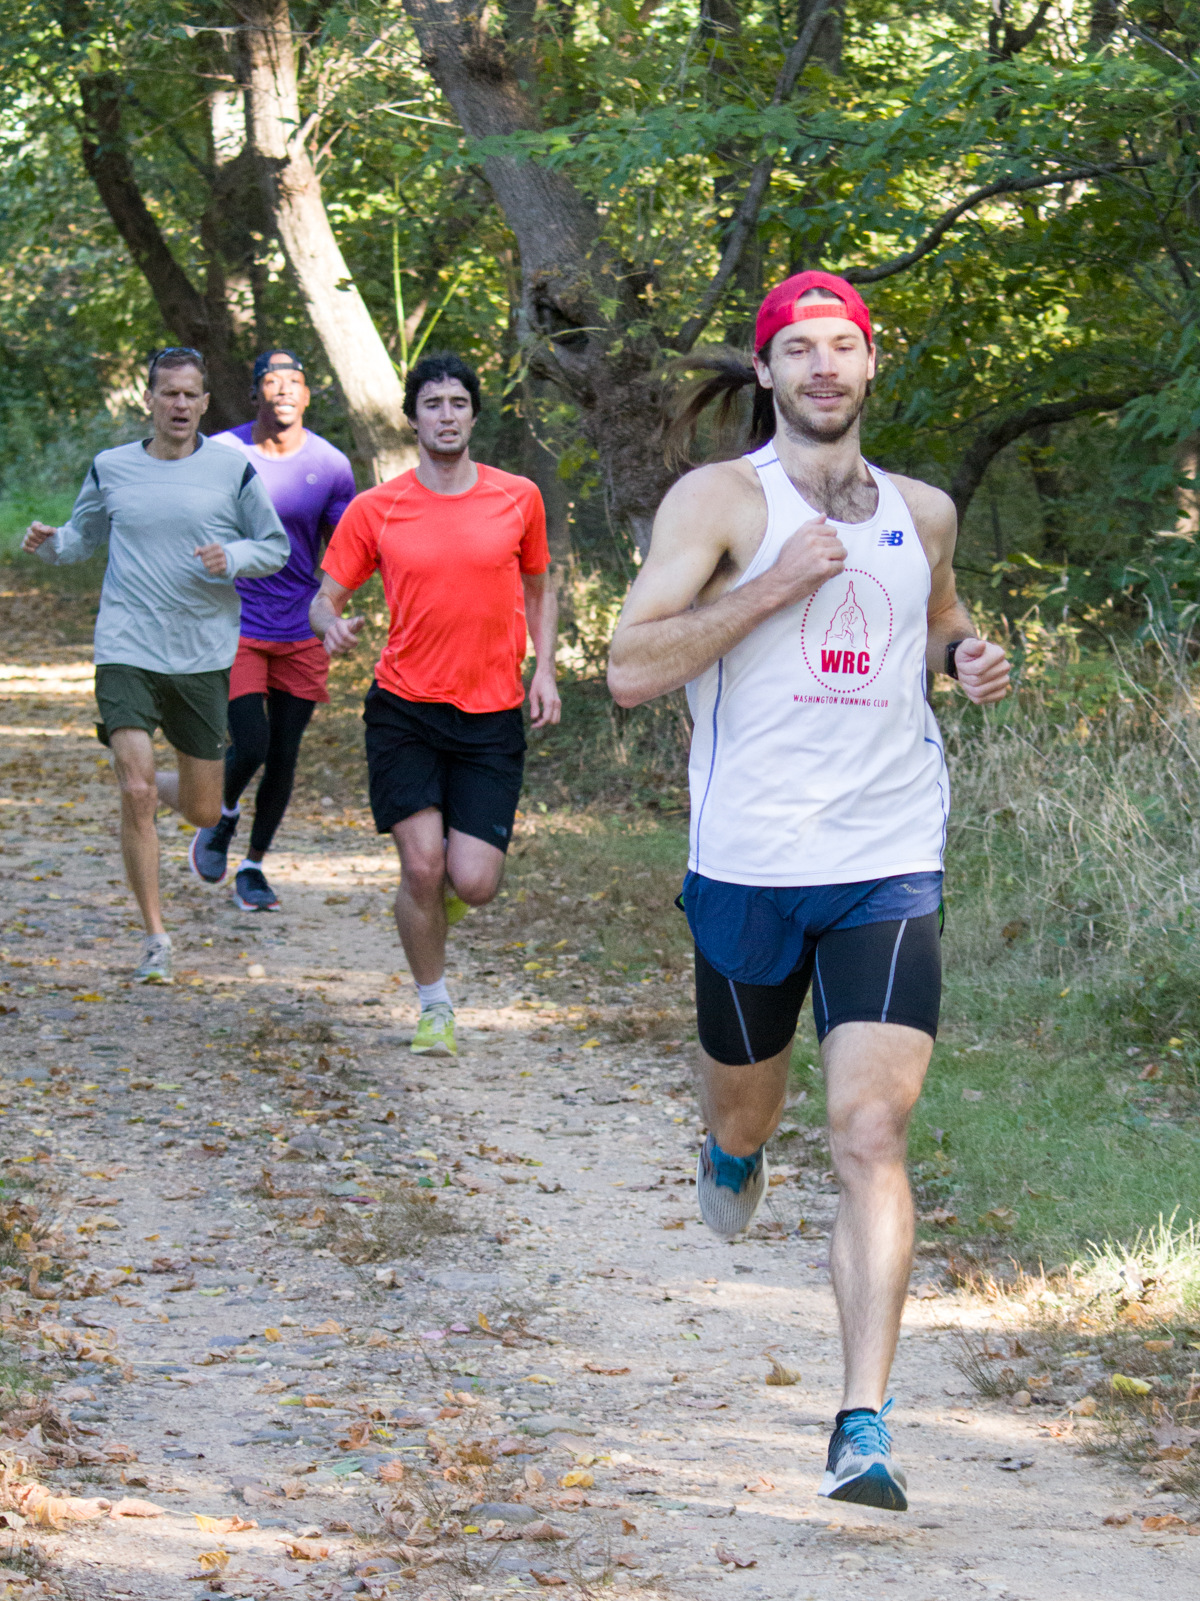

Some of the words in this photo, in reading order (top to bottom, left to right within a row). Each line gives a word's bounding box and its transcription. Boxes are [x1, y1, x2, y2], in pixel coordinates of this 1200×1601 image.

[820, 649, 871, 675] WRC
[793, 694, 838, 704] WASHINGTON
[840, 697, 871, 707] RUNNING
[873, 699, 889, 708] CLUB
